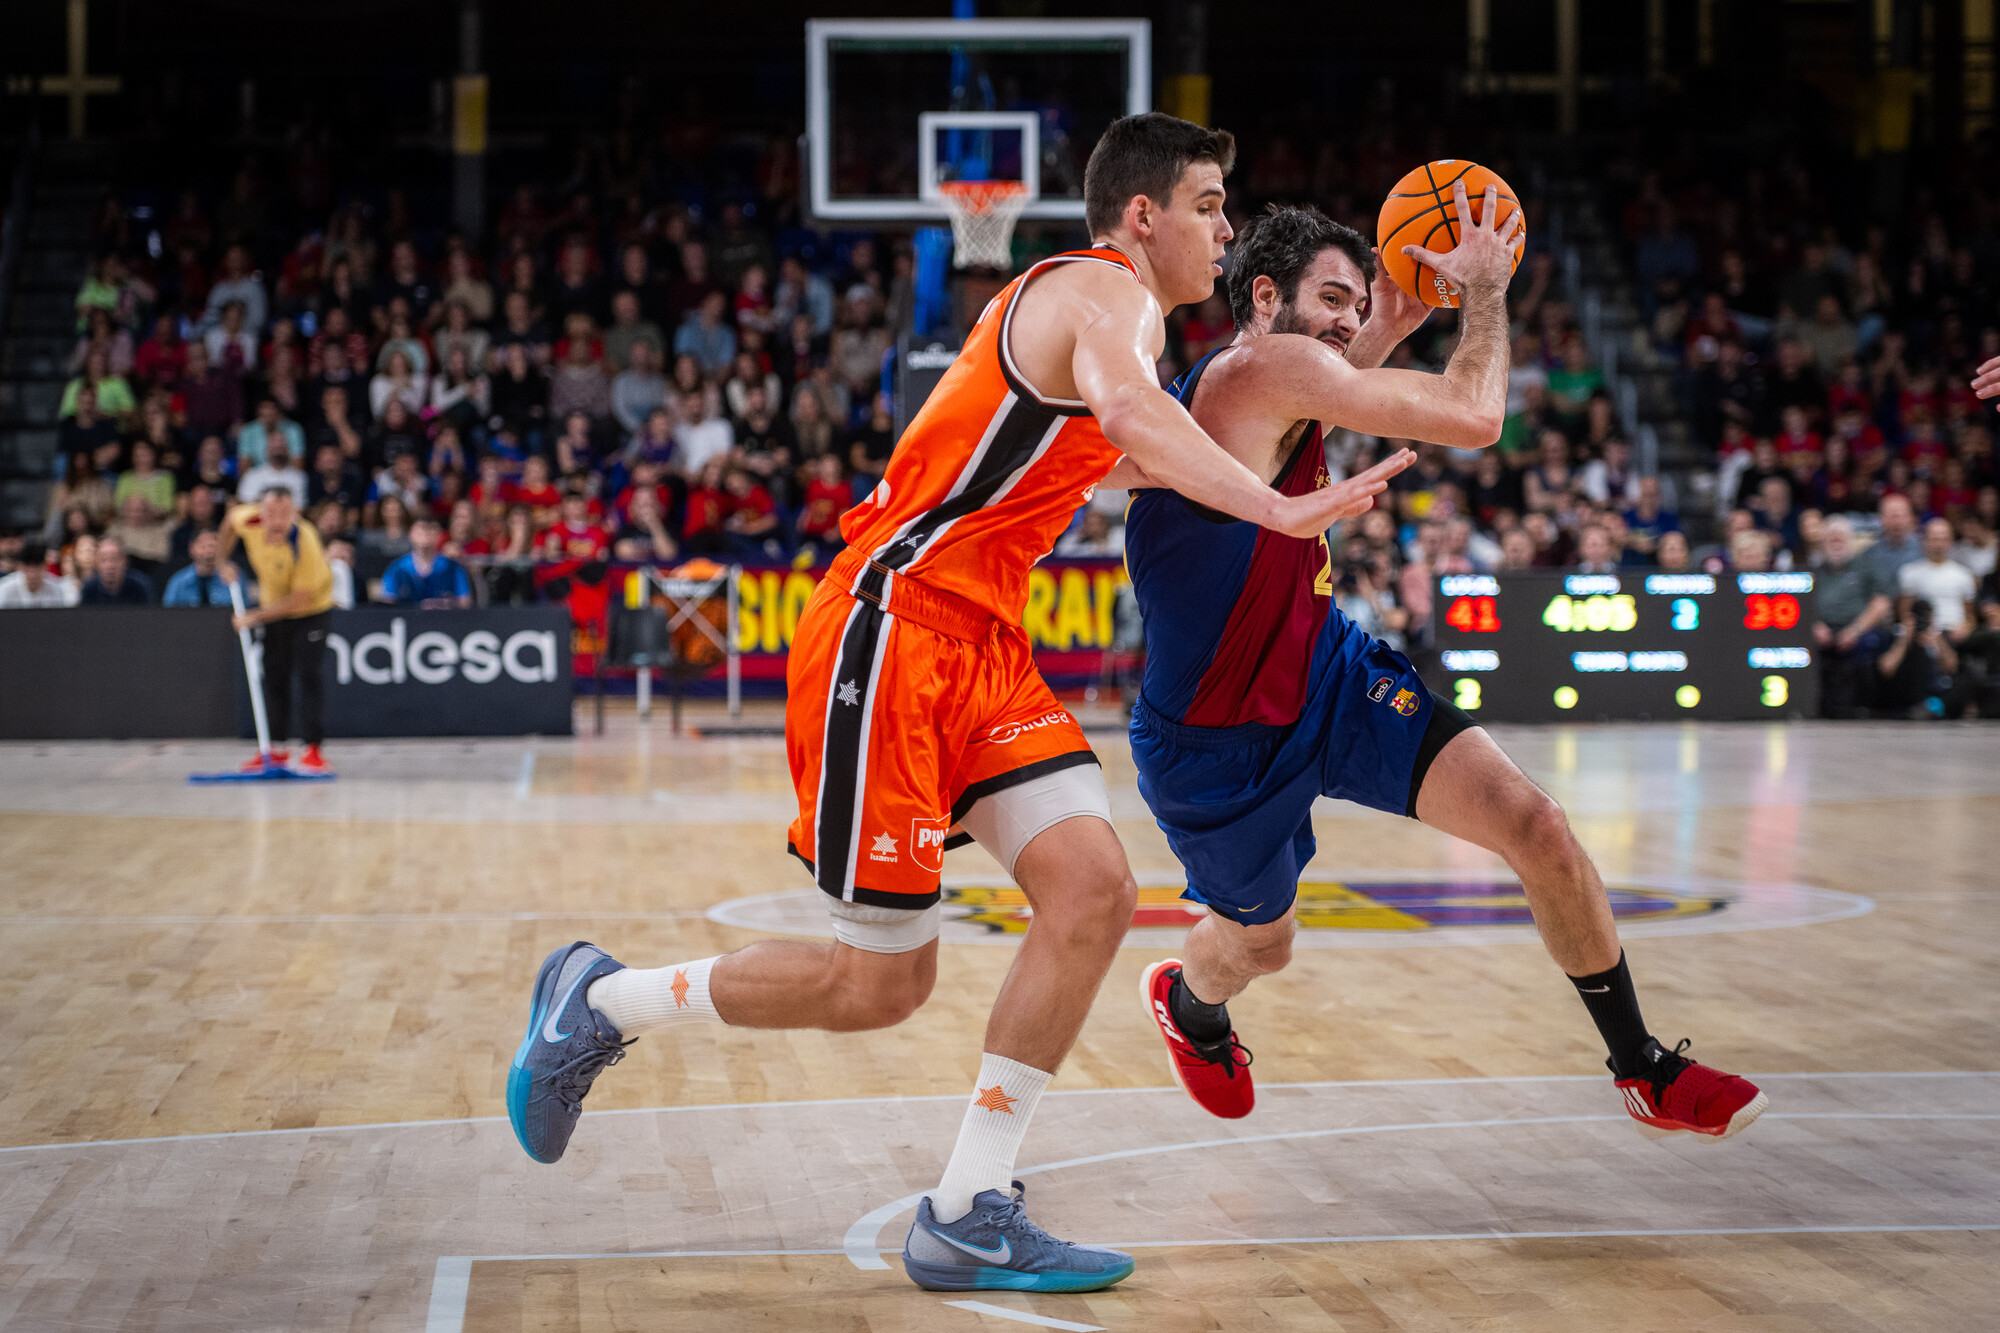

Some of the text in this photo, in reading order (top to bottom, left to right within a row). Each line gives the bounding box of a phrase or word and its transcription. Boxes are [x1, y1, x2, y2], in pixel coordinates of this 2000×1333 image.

[1446, 596, 1501, 632] 41
[1374, 683, 1389, 699] acb
[870, 853, 898, 863] luanvi
